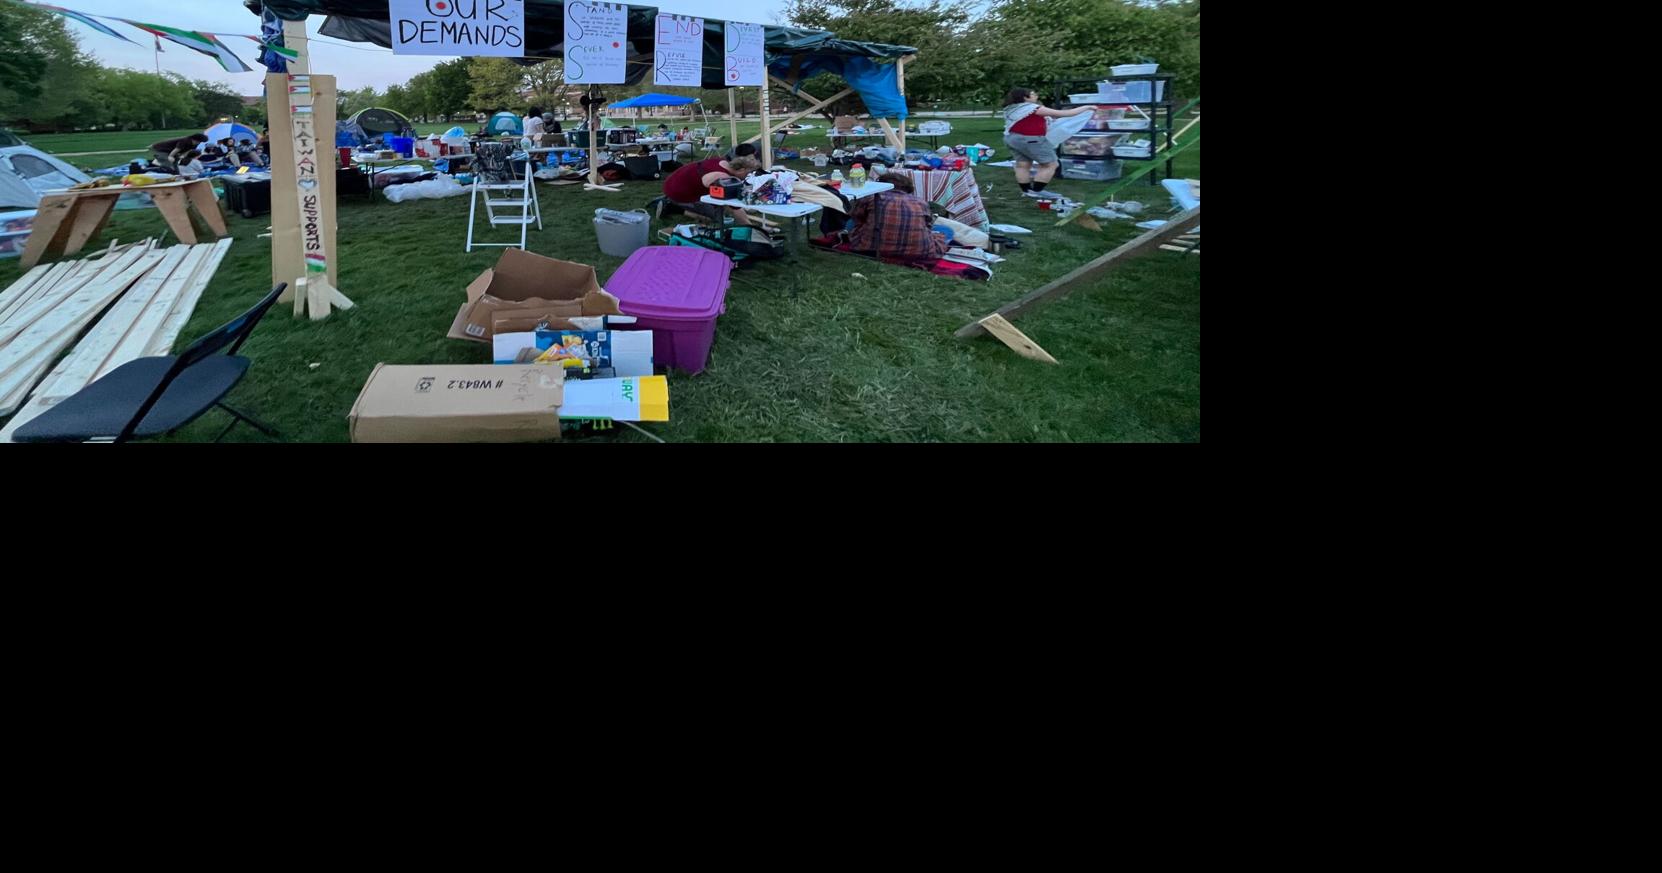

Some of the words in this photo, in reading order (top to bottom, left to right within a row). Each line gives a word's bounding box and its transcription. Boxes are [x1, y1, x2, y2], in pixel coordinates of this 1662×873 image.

[425, 0, 508, 21] OUR
[567, 1, 613, 41] STAND
[398, 19, 523, 48] DEMANDS
[657, 15, 702, 45] END
[294, 120, 315, 177] TAIWAN
[303, 195, 320, 251] SUPPORTS
[447, 379, 493, 390] W843.2
